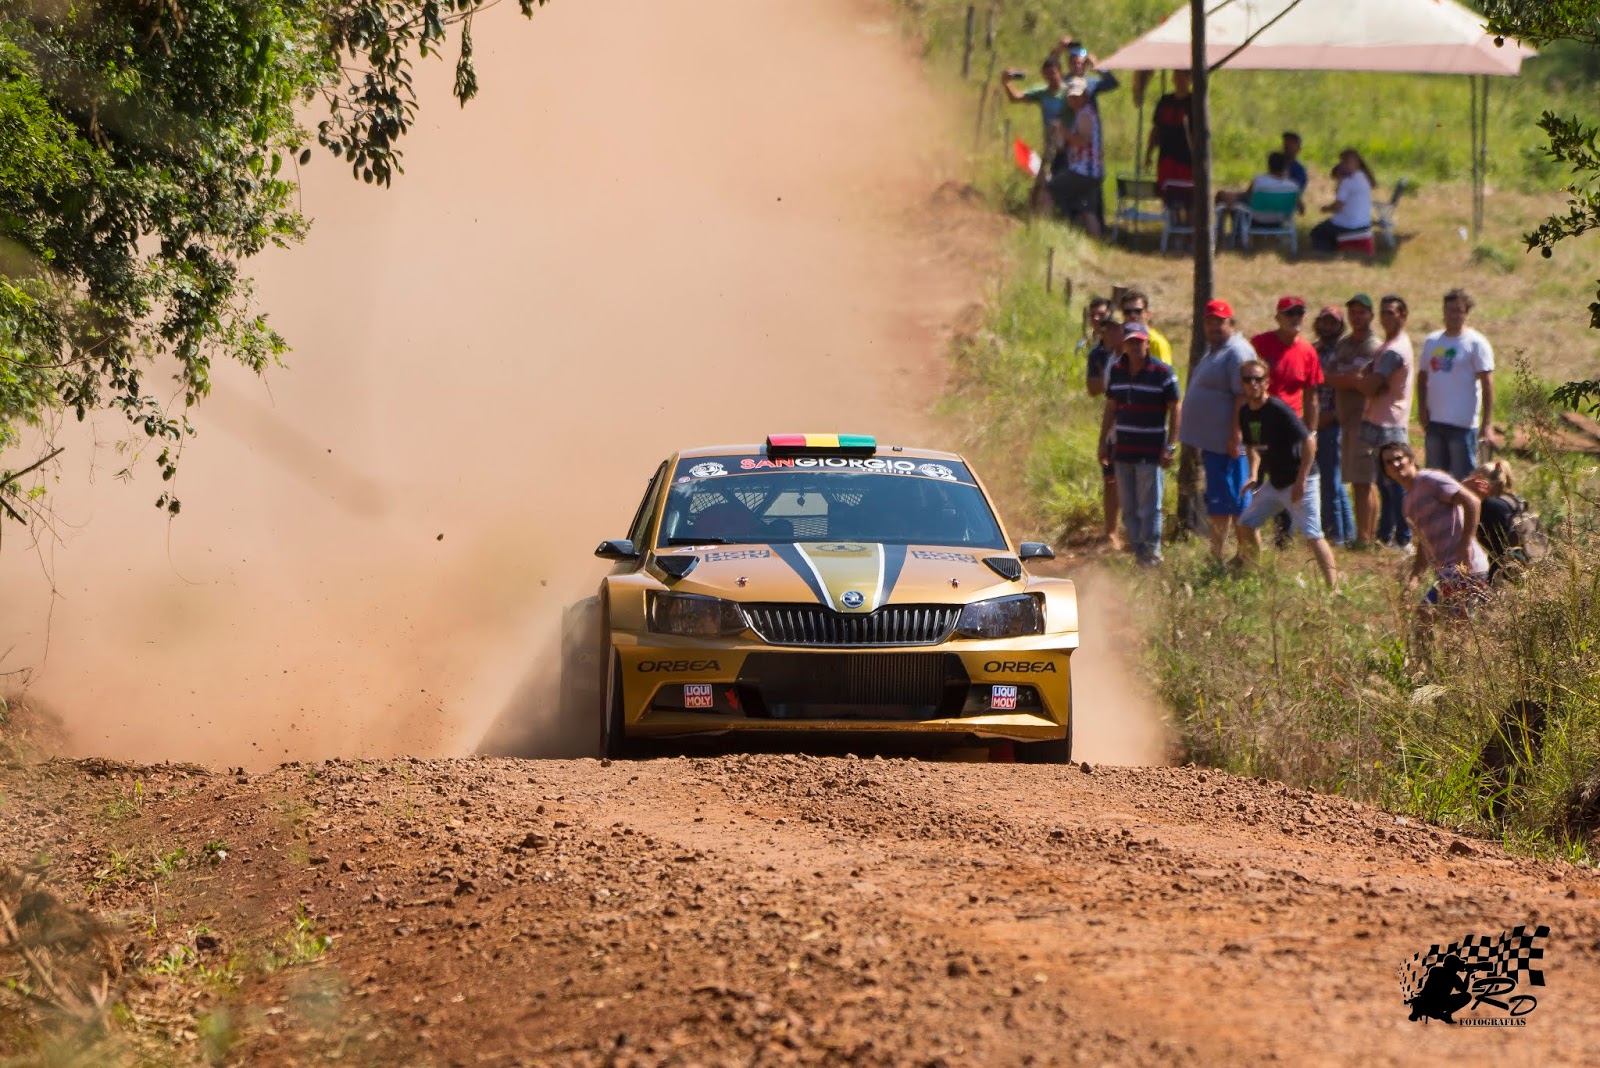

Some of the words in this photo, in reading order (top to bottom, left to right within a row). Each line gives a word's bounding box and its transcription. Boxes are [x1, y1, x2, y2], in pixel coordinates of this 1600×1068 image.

[740, 457, 916, 471] SANGIORGIO
[637, 660, 721, 672] ORBEA
[983, 660, 1057, 673] ORBEA
[686, 686, 710, 696] LIQUI
[994, 687, 1015, 697] LIQUI
[686, 696, 711, 706] MOLY
[993, 697, 1015, 708] MOLY
